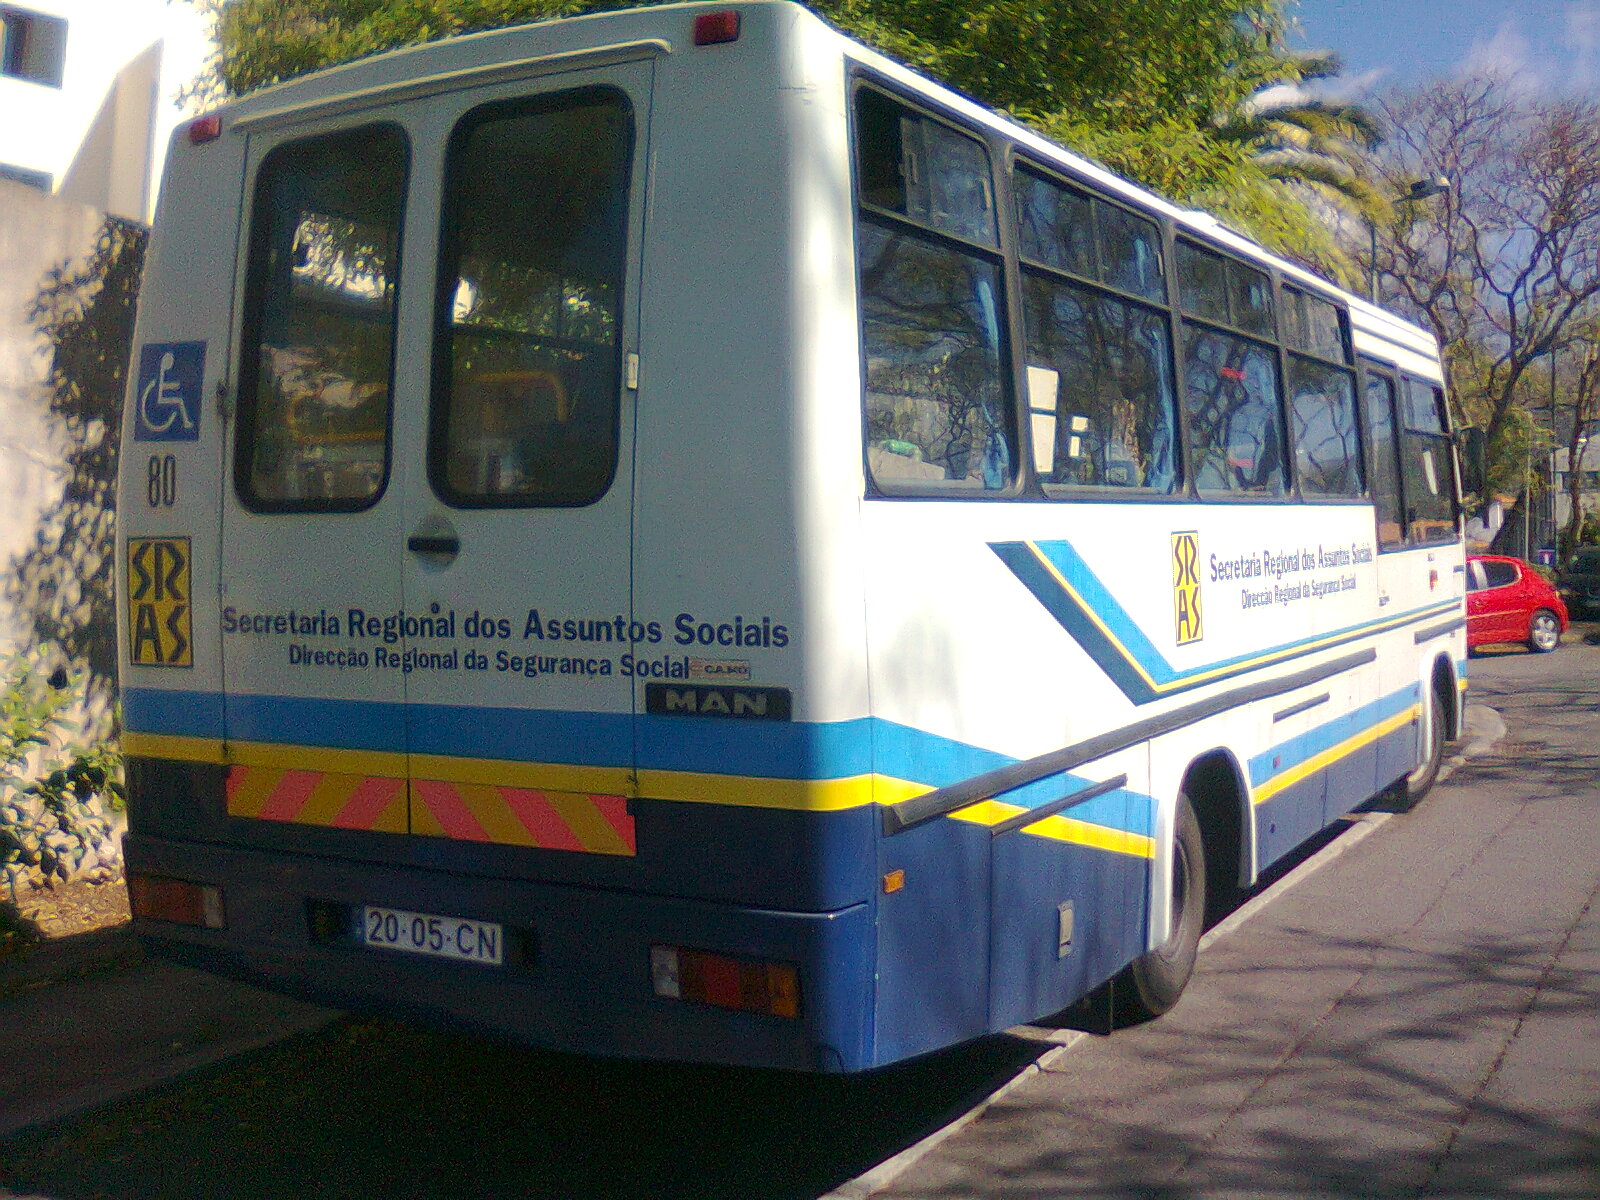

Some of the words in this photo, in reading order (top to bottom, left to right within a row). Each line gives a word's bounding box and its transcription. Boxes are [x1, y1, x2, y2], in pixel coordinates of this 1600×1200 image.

[149, 455, 176, 507] 80
[1210, 548, 1262, 582] Secretaria
[1263, 549, 1300, 580] Regional
[1302, 547, 1316, 571] dos
[222, 606, 340, 636] Secretaria
[348, 608, 456, 644] Regional
[464, 610, 512, 640] dos
[522, 608, 663, 645] Assuntos
[673, 612, 790, 649] Sociais
[374, 646, 458, 674] Regional
[463, 650, 489, 671] da
[619, 653, 690, 680] Social
[665, 689, 769, 716] MAN
